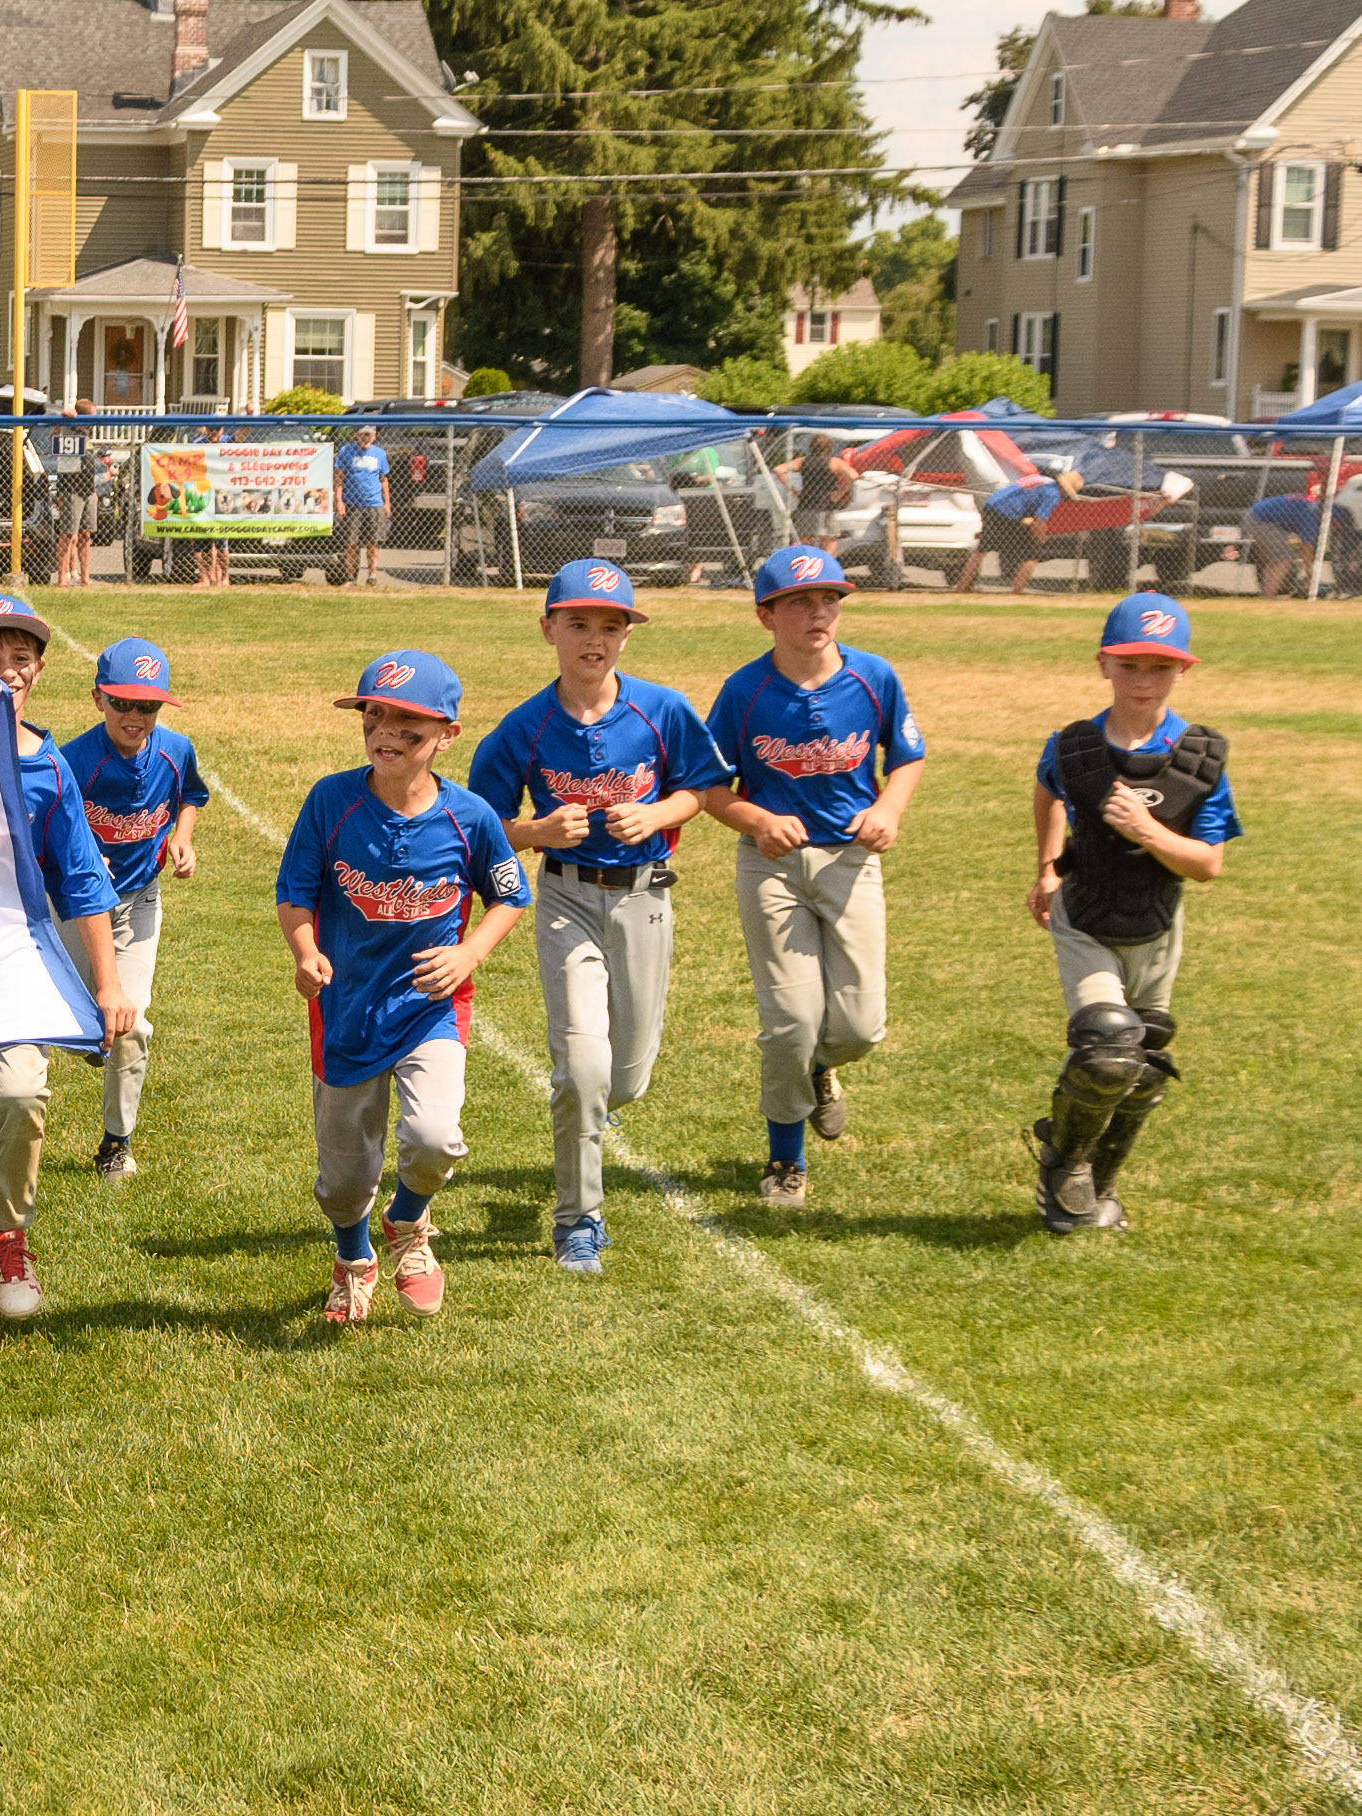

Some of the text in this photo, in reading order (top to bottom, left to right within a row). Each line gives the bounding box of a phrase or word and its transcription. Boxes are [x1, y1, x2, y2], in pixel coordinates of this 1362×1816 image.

[58, 436, 80, 454] 191
[262, 448, 283, 457] DAY
[156, 454, 203, 468] CAMP
[168, 467, 192, 480] K-9
[790, 556, 824, 581] W
[587, 567, 620, 593] W
[134, 656, 162, 680] W
[375, 660, 416, 689] W
[377, 904, 395, 916] ALL
